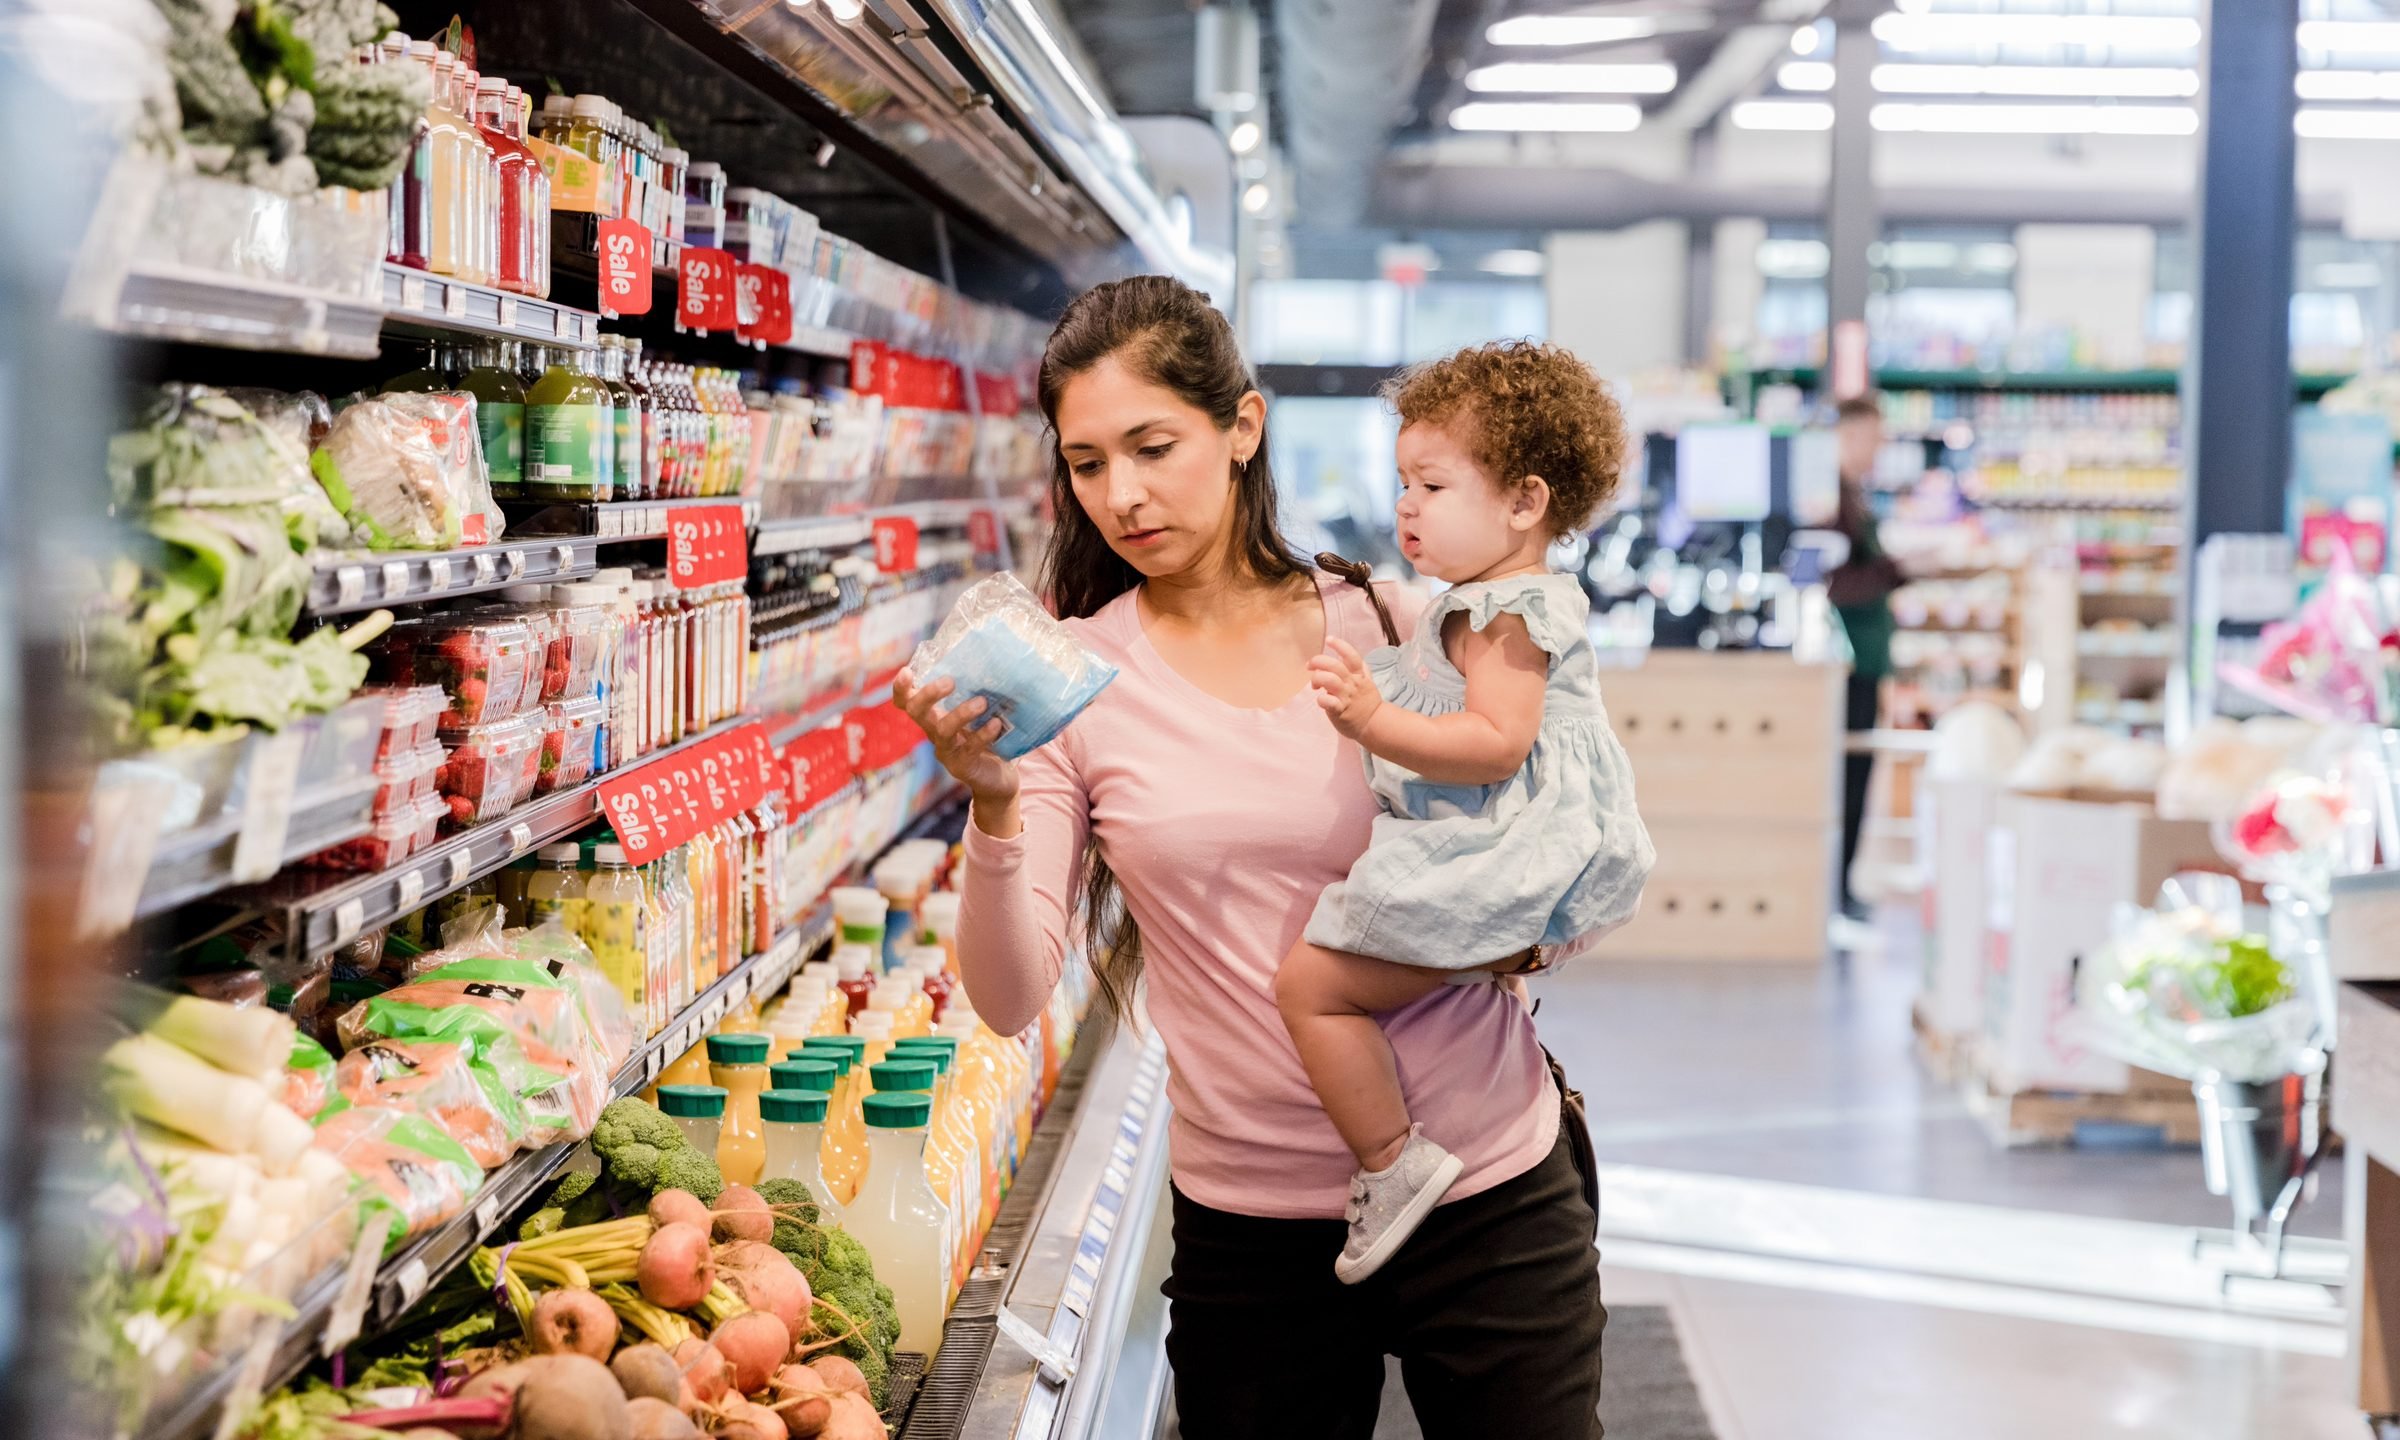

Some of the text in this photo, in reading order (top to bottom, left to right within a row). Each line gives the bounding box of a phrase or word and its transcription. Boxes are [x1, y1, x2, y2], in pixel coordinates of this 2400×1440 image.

[607, 234, 637, 295] Sale
[686, 259, 711, 315] Sale
[674, 521, 699, 576] Sale
[611, 792, 650, 851] Sale
